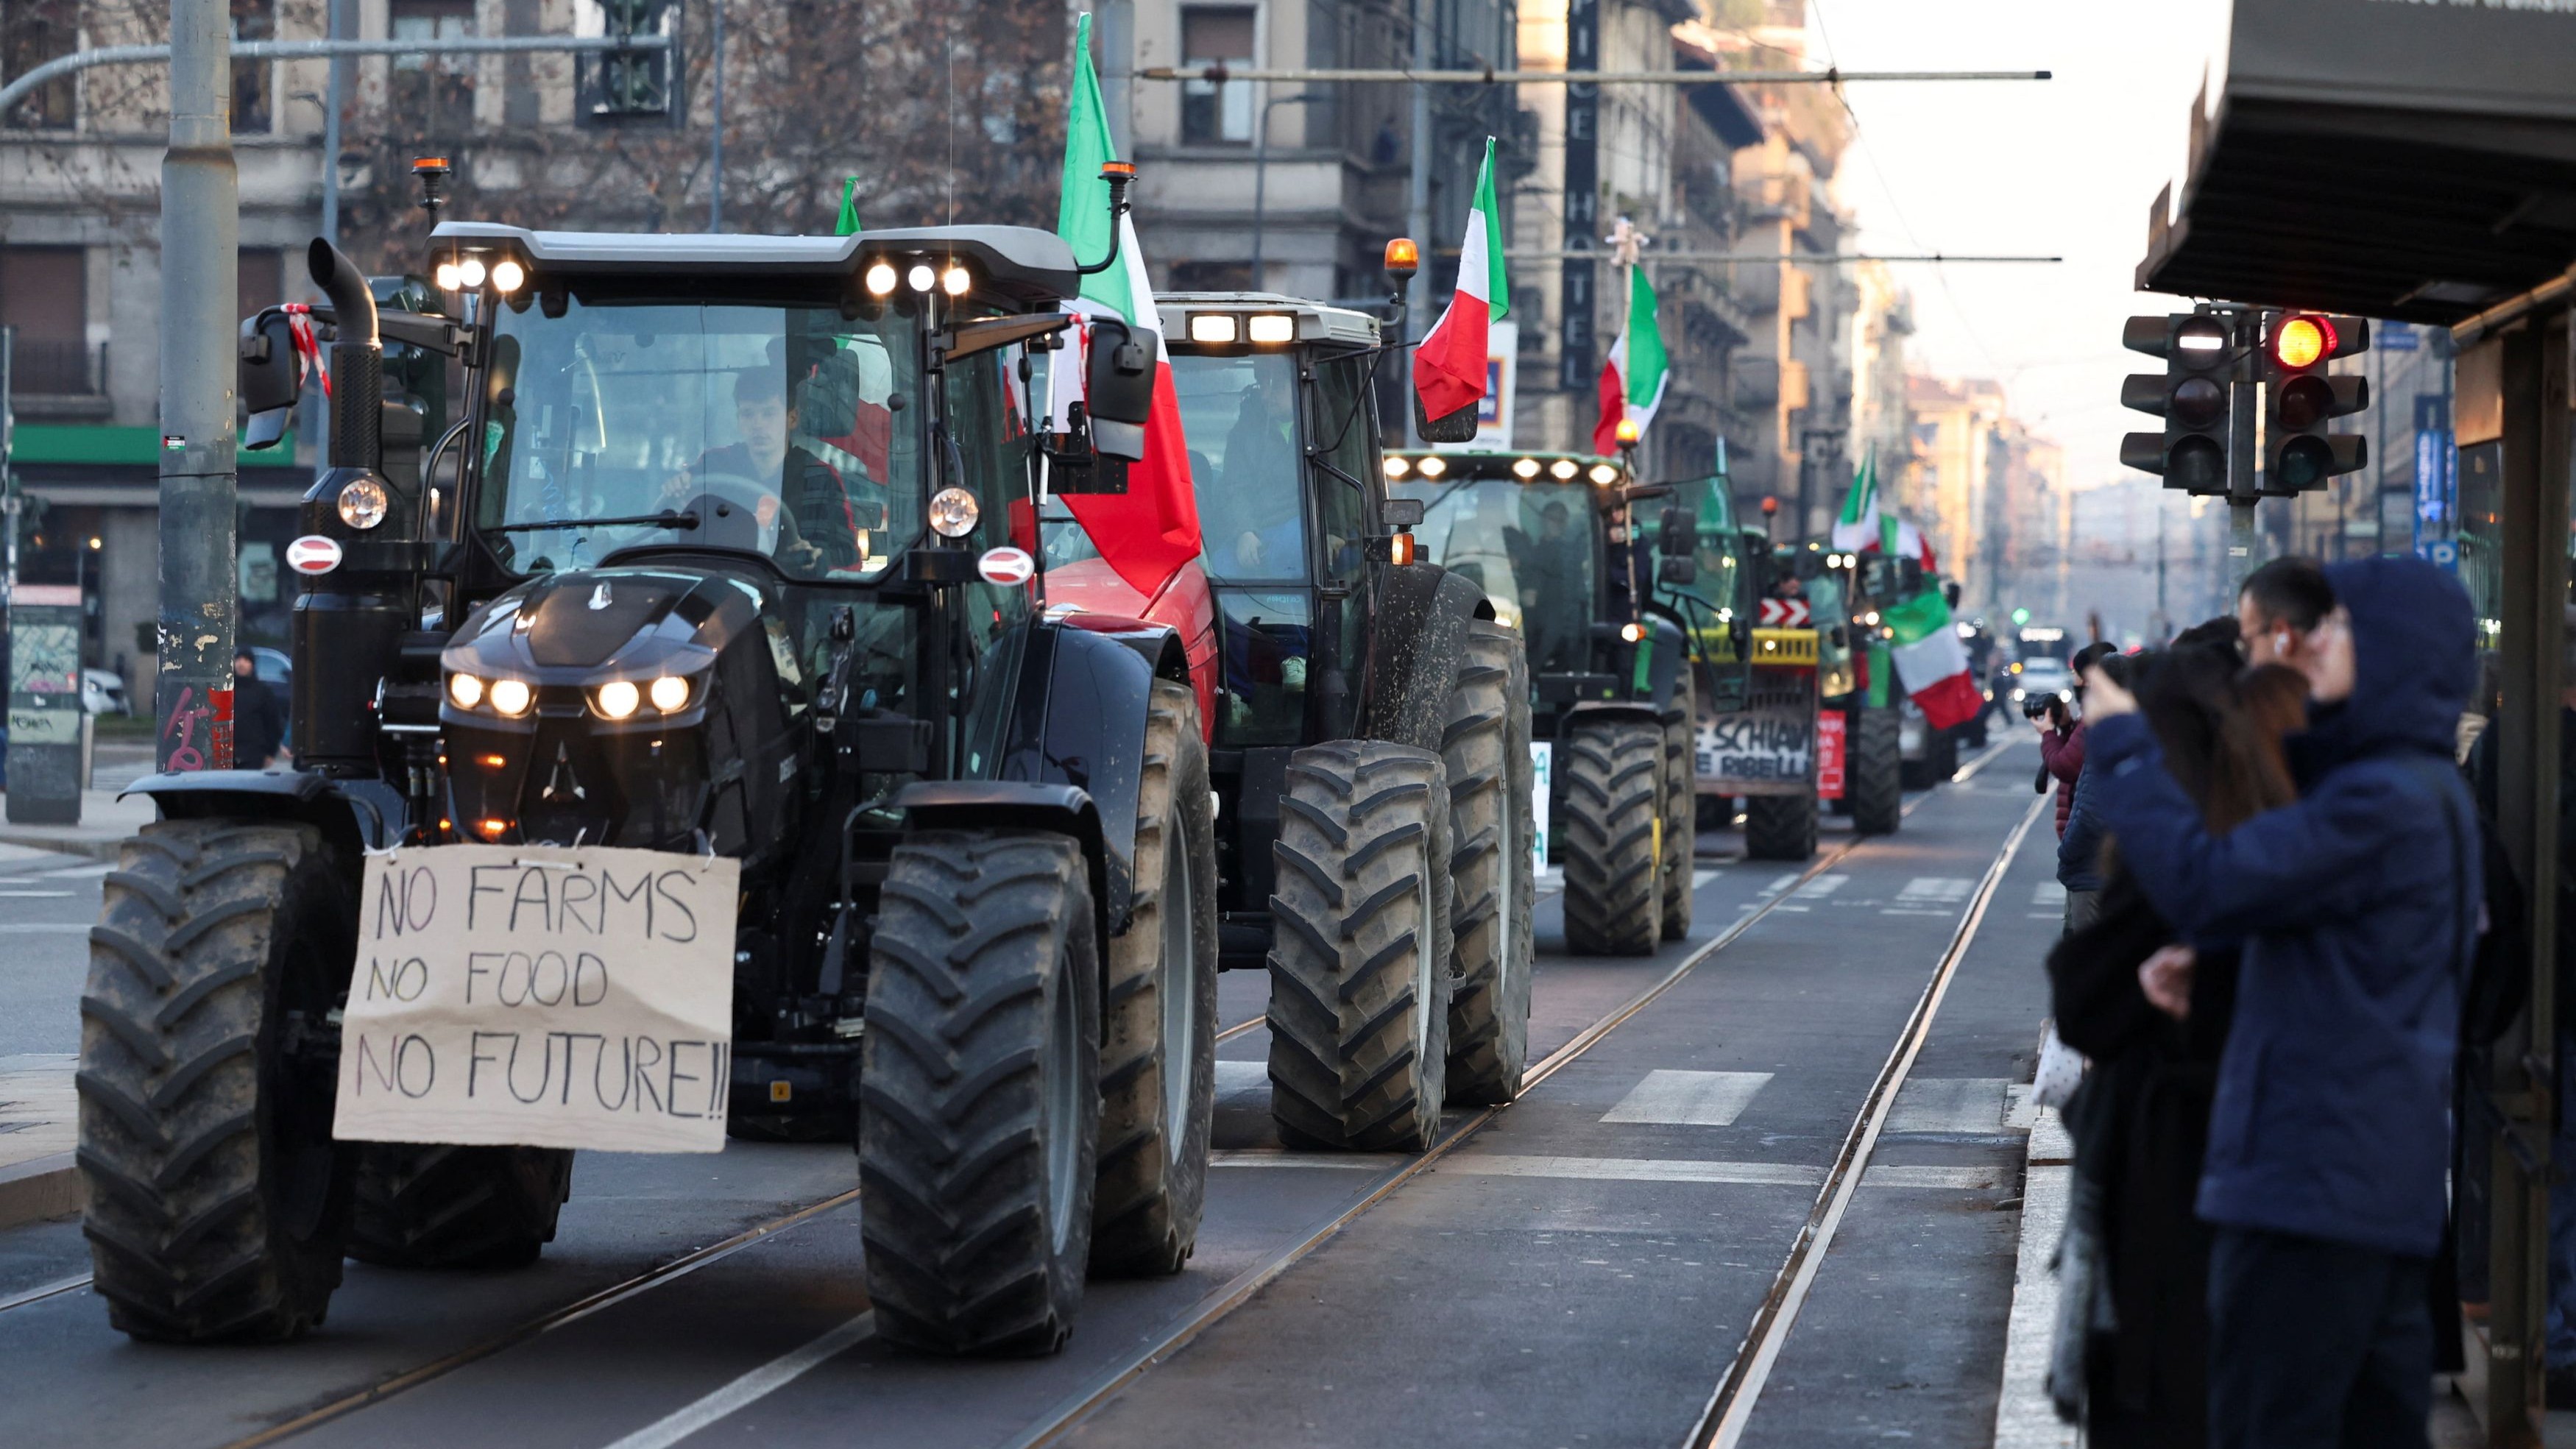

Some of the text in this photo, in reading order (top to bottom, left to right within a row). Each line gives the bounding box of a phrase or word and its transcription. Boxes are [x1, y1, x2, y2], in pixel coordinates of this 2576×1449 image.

[1565, 191, 1596, 386] HOTEL
[377, 865, 697, 943] NO FARMS
[367, 950, 609, 1007] NO FOOD
[357, 1031, 729, 1120] NO FUTURE!!
